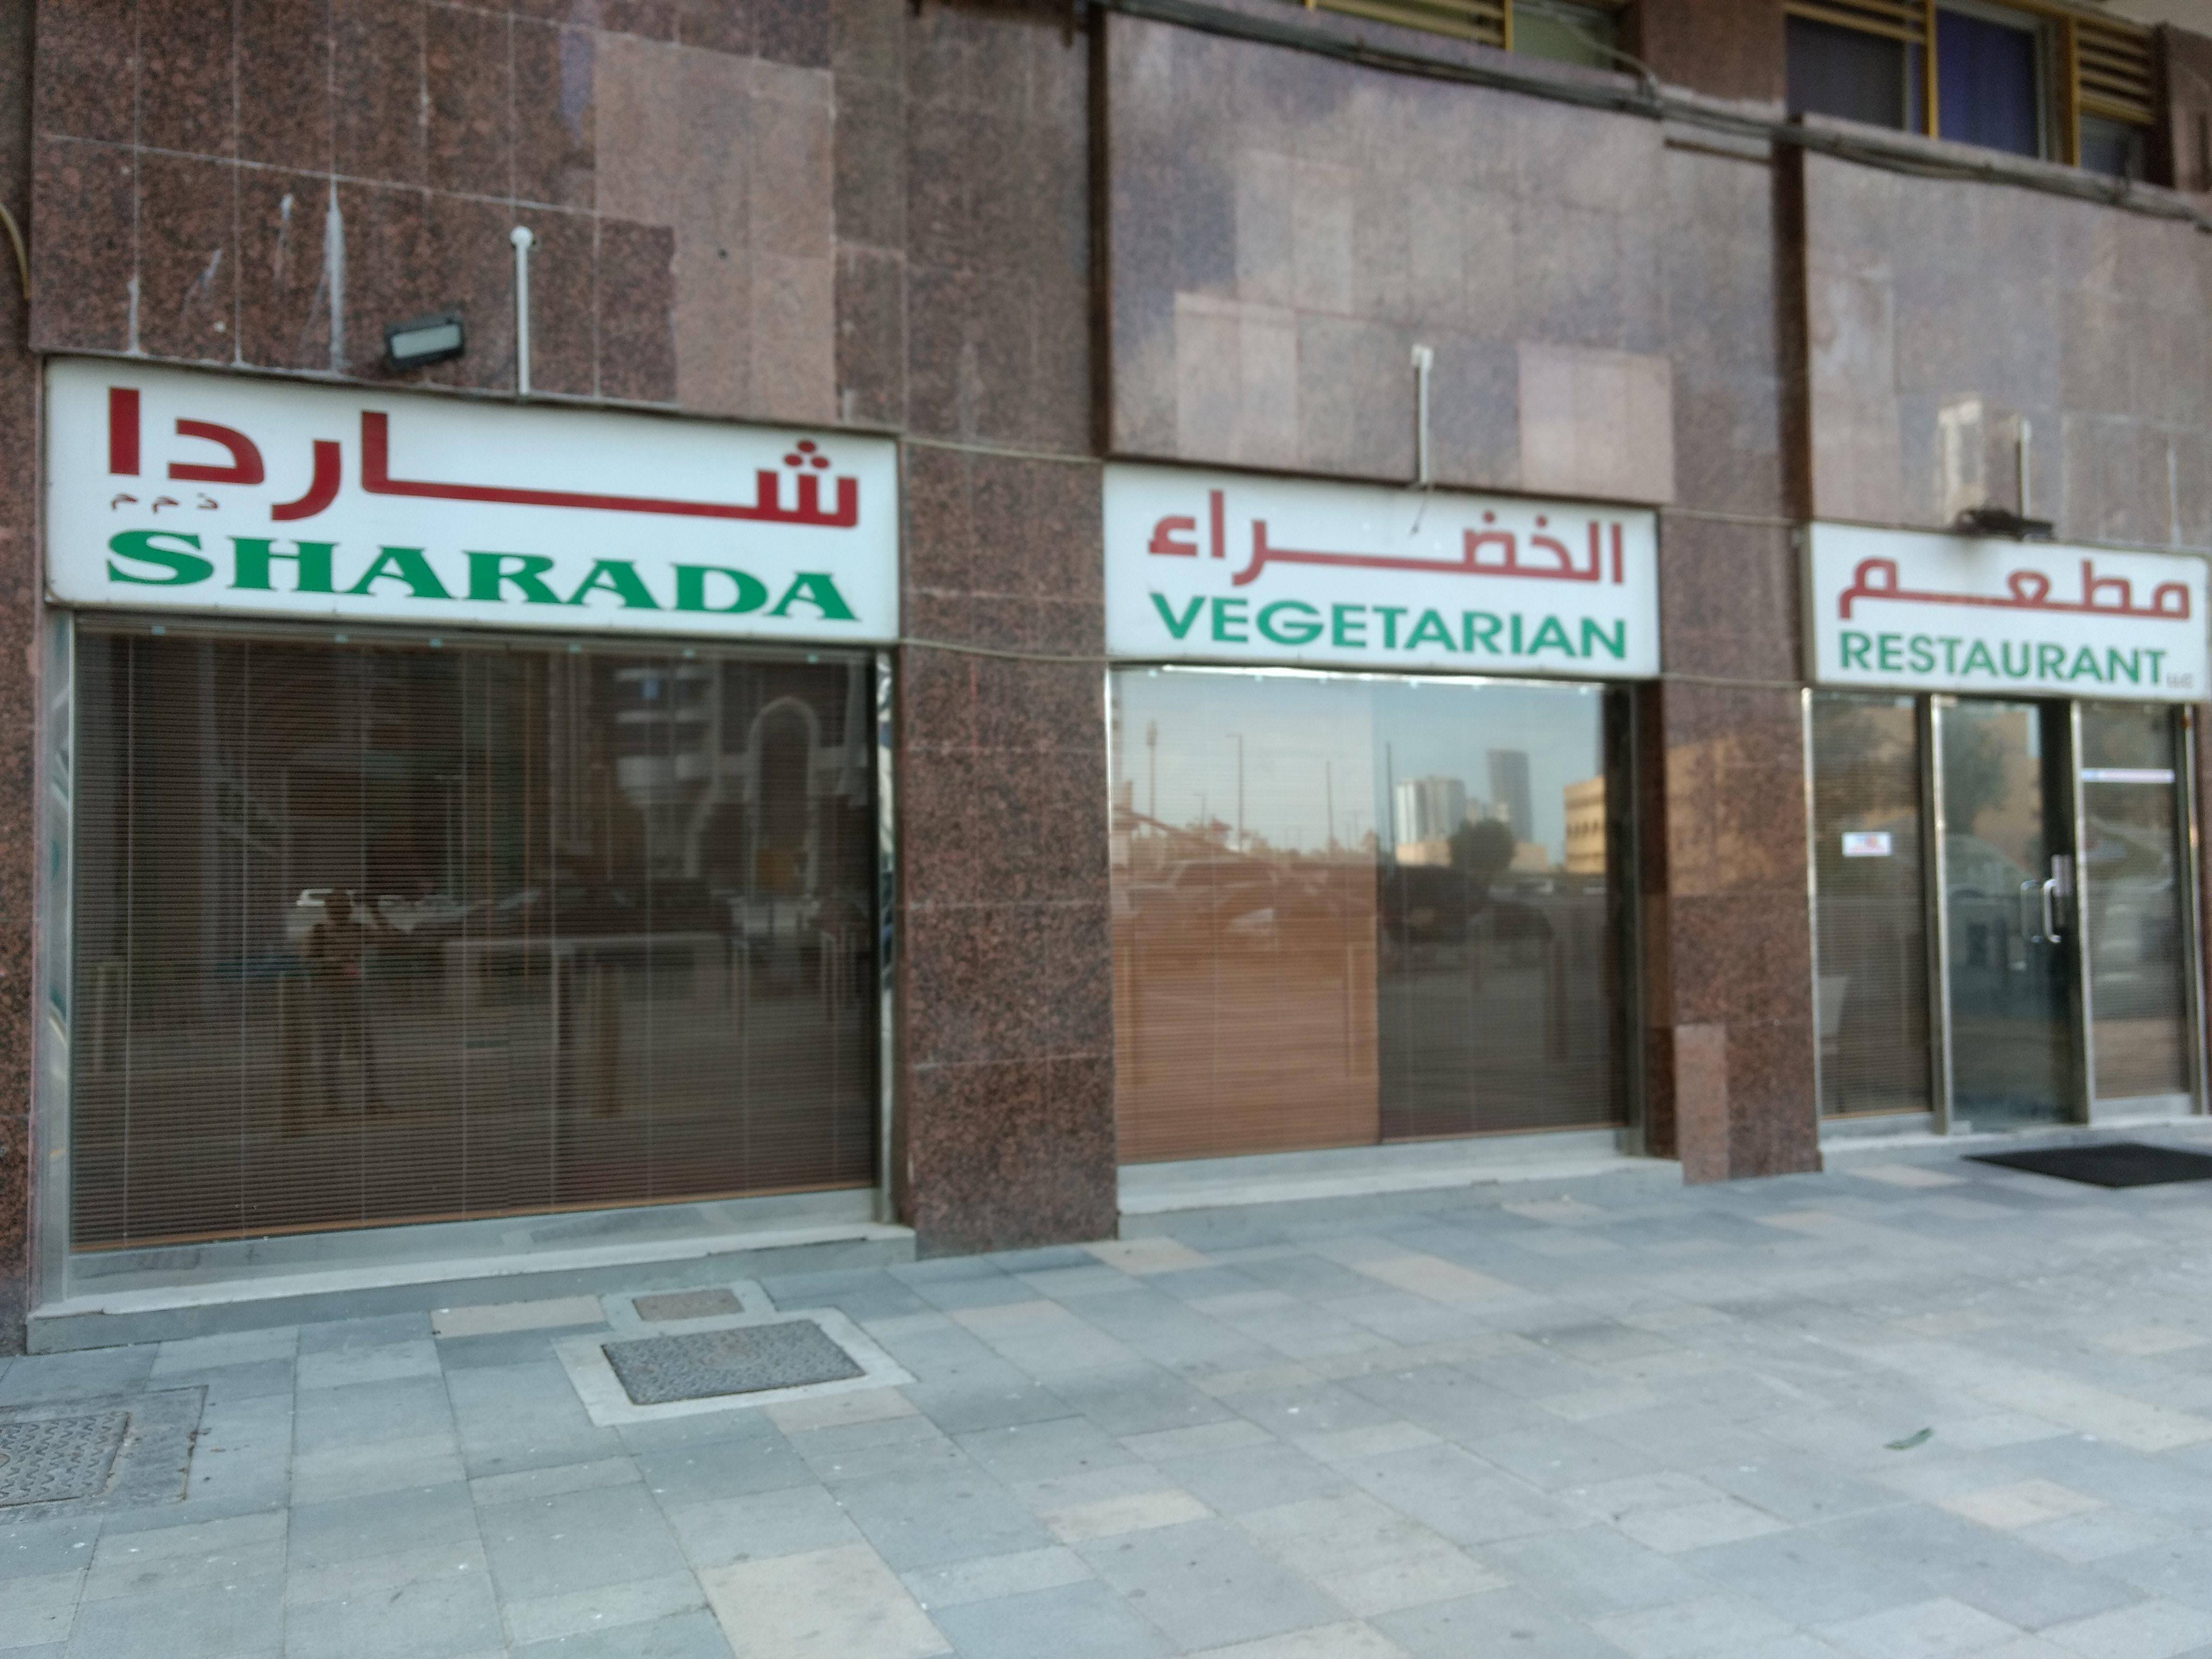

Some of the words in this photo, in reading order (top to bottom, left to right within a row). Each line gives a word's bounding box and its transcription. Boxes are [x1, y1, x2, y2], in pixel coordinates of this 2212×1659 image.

[108, 386, 858, 528] شاردا
[106, 529, 861, 622] SHARADA
[1148, 490, 1624, 586] الخضراء
[1150, 592, 1625, 659] VEGETARIAN
[1838, 556, 2190, 621] مطعم
[1839, 630, 2166, 685] RESTAURANT
